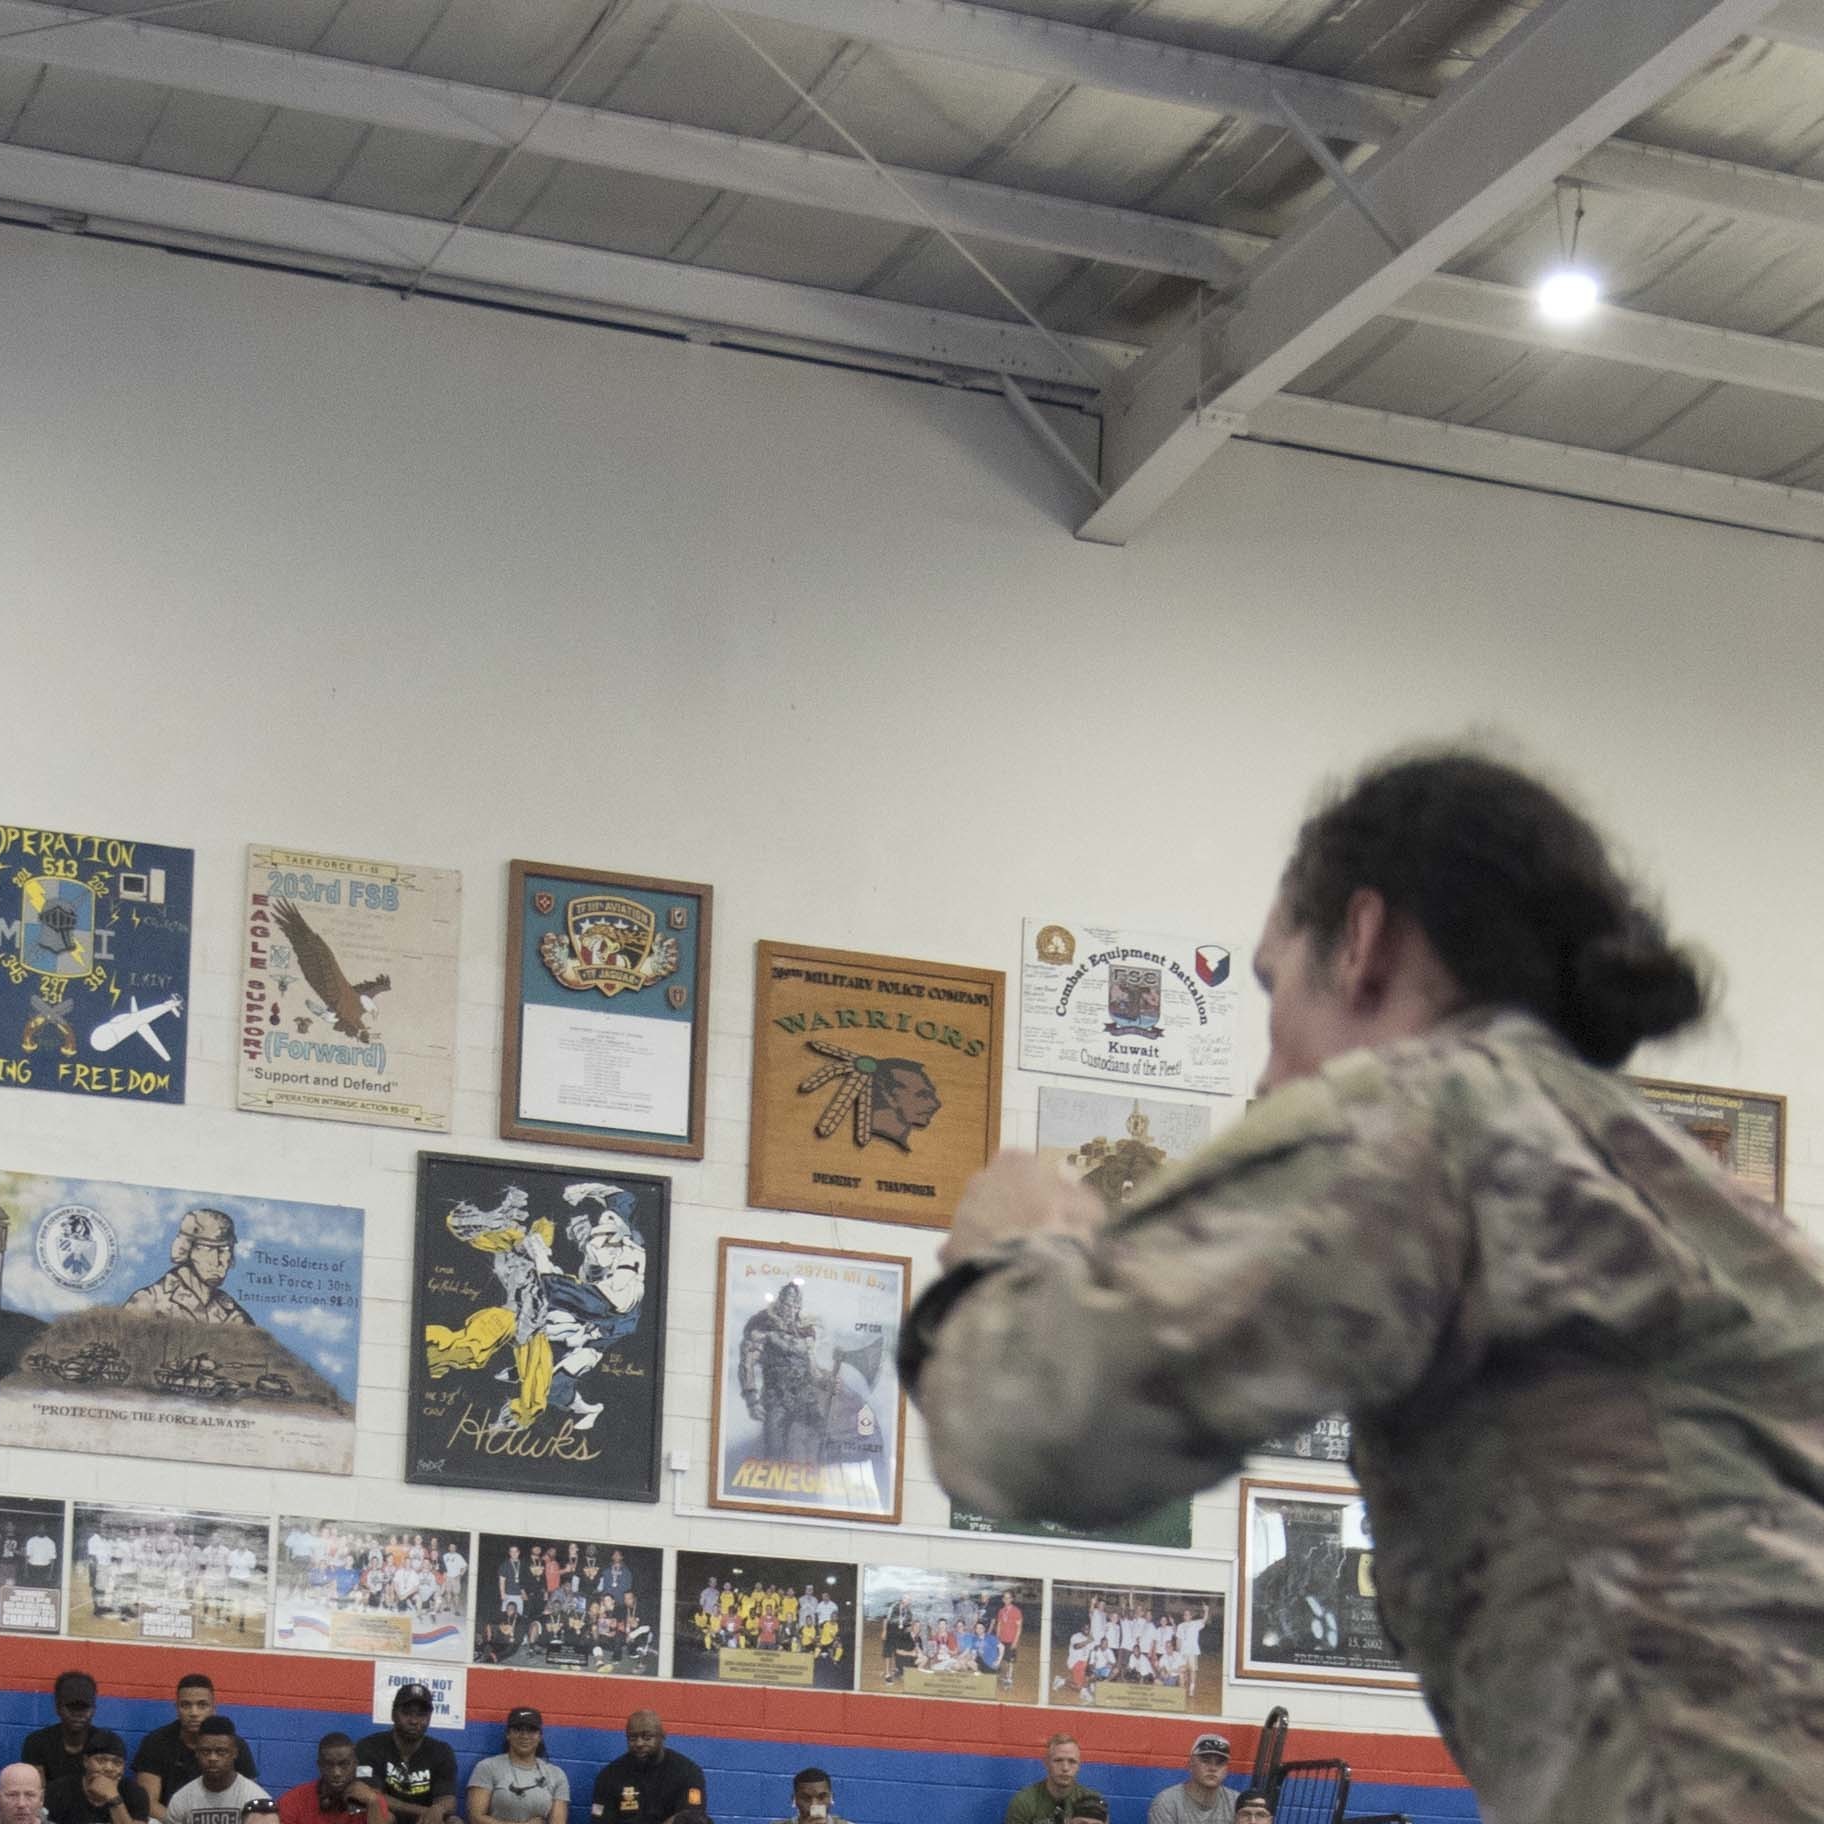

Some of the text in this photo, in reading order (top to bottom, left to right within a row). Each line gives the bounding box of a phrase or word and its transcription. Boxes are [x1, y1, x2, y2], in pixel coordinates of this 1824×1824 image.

[43, 856, 78, 877] 513
[285, 855, 352, 872] TASK FORCE
[12, 867, 33, 888] 201
[87, 875, 110, 898] 202
[267, 870, 400, 912] 203rd FSB
[250, 894, 270, 970] EAGLE
[94, 929, 116, 961] I
[2, 954, 28, 985] 345
[84, 966, 108, 992] 319
[40, 976, 68, 993] 297
[805, 970, 992, 1007] MILITARY POLICE COMPANY
[1055, 963, 1090, 1018] Combat
[1088, 946, 1167, 967] Equipment
[1169, 960, 1207, 1026] Battalion
[243, 980, 267, 1060] SUPPORT
[773, 1008, 985, 1057] WARRIORS
[264, 1030, 386, 1075] (Forward)
[1108, 1041, 1159, 1058] Kuwait
[1080, 1048, 1131, 1074] Custodians
[1133, 1059, 1143, 1076] of
[1143, 1060, 1158, 1076] the
[58, 1063, 169, 1094] FREEDOM
[313, 1074, 339, 1087] and
[812, 1172, 937, 1198] DESERT THUNDER
[255, 1250, 346, 1273] The Soldiers of
[796, 1263, 838, 1281] 297th
[246, 1271, 274, 1286] Task
[278, 1273, 314, 1290] Force
[290, 1292, 328, 1306] Action
[131, 1409, 155, 1423] THE
[158, 1411, 198, 1427] FORCE
[447, 1403, 603, 1462] Hawks
[431, 1678, 453, 1691] NOT
[433, 1703, 451, 1716] YM
